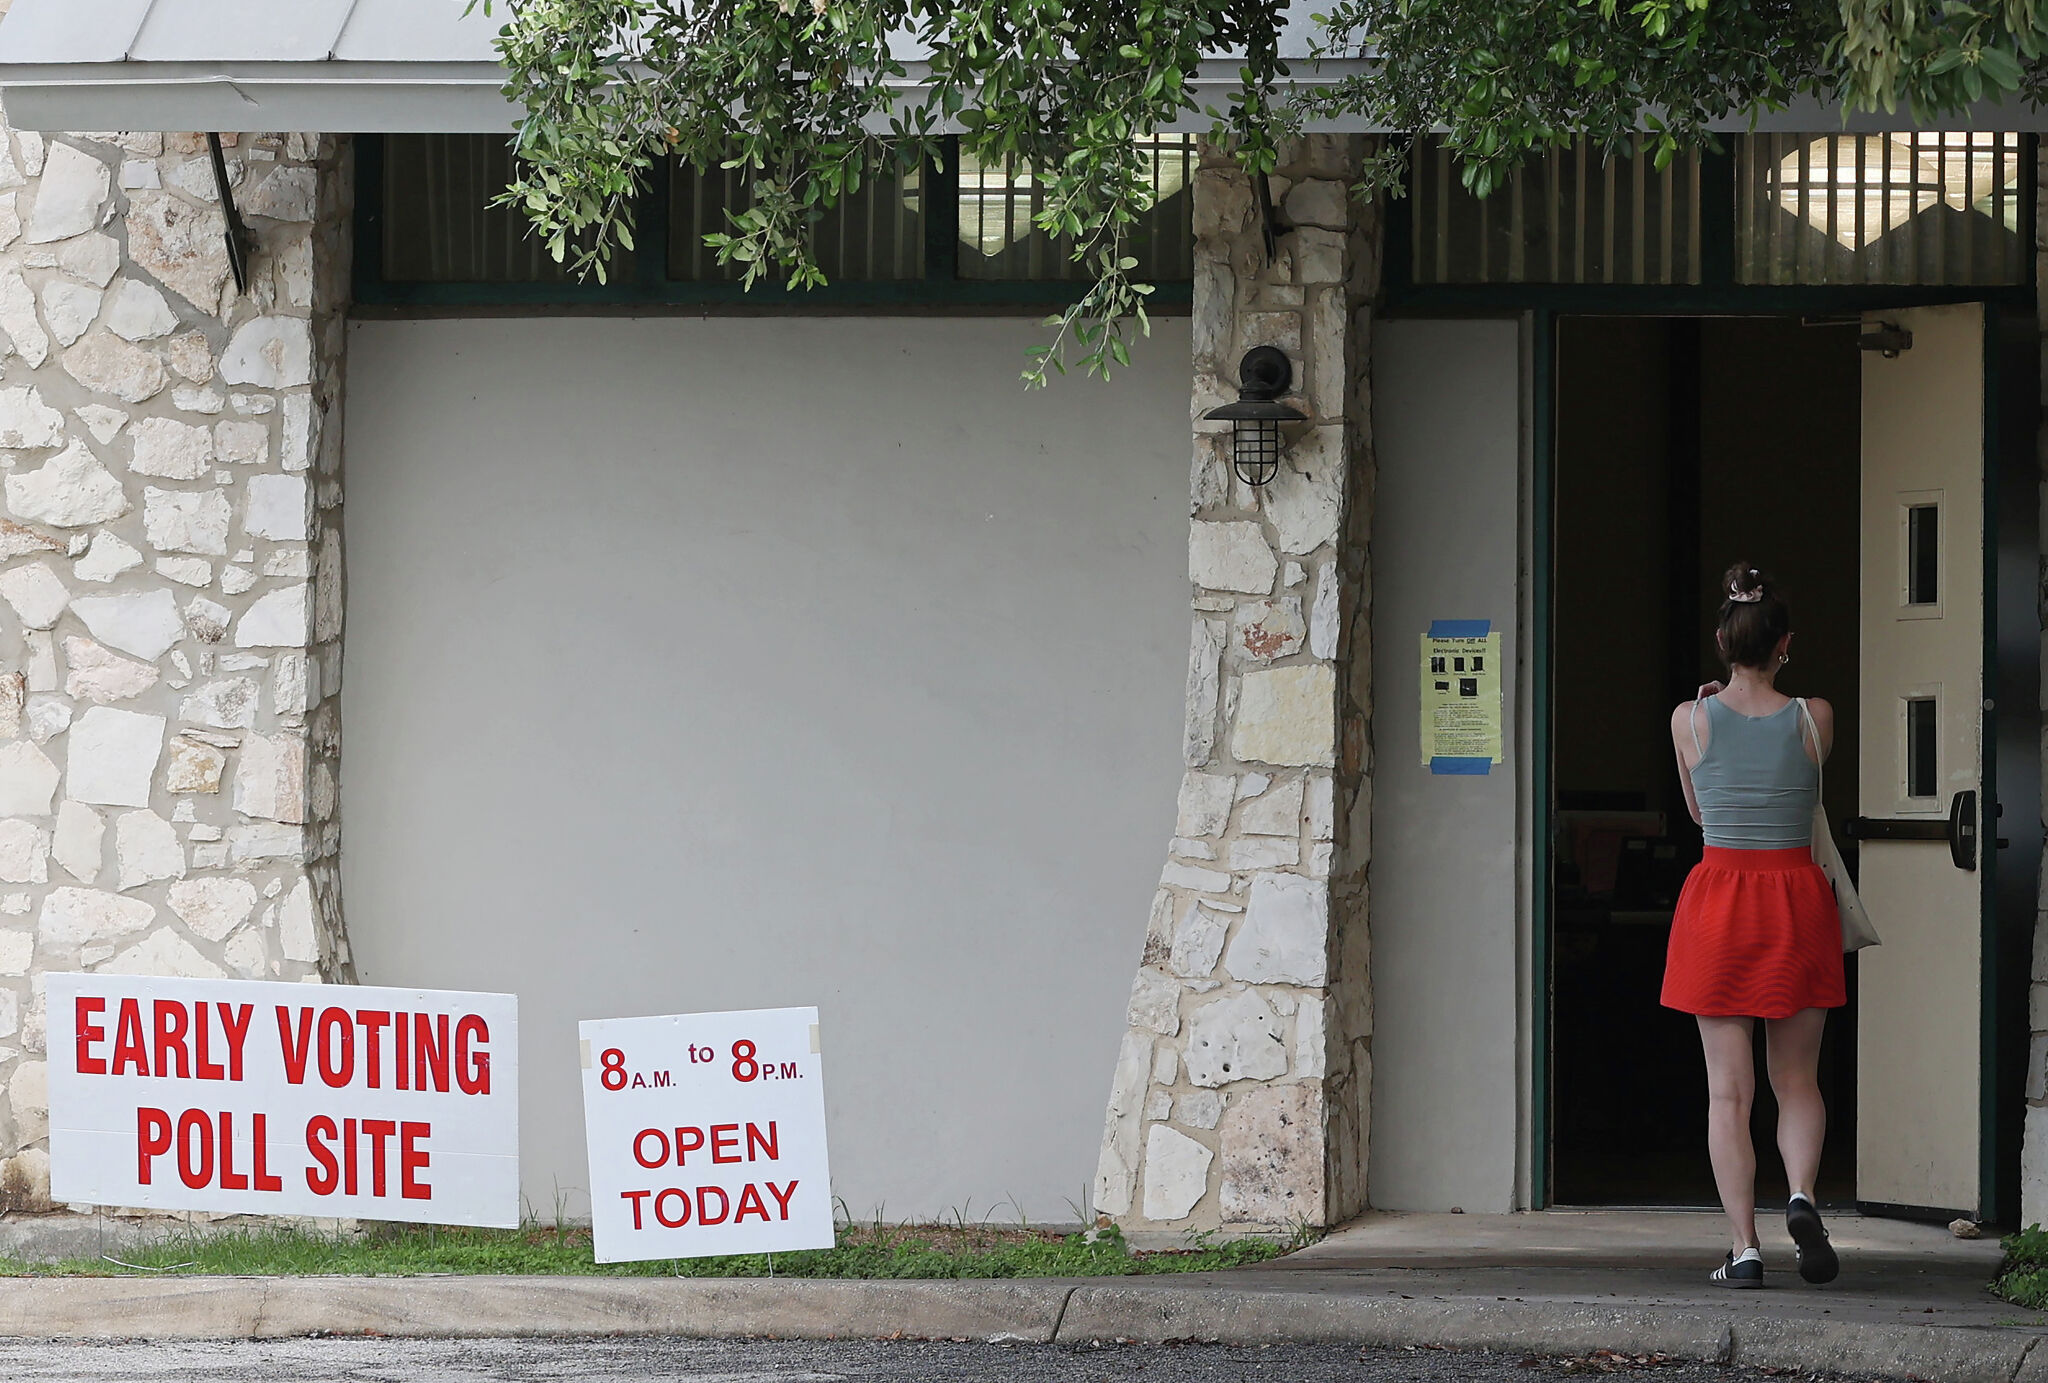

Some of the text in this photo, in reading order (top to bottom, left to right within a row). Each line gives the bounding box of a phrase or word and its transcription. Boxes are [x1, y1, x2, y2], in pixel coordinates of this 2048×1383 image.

[75, 996, 491, 1096] EARLY VOTING
[688, 1043, 714, 1063] to
[137, 1106, 432, 1200] POLL SITE
[632, 1121, 779, 1169] OPEN
[620, 1180, 800, 1230] TODAY
